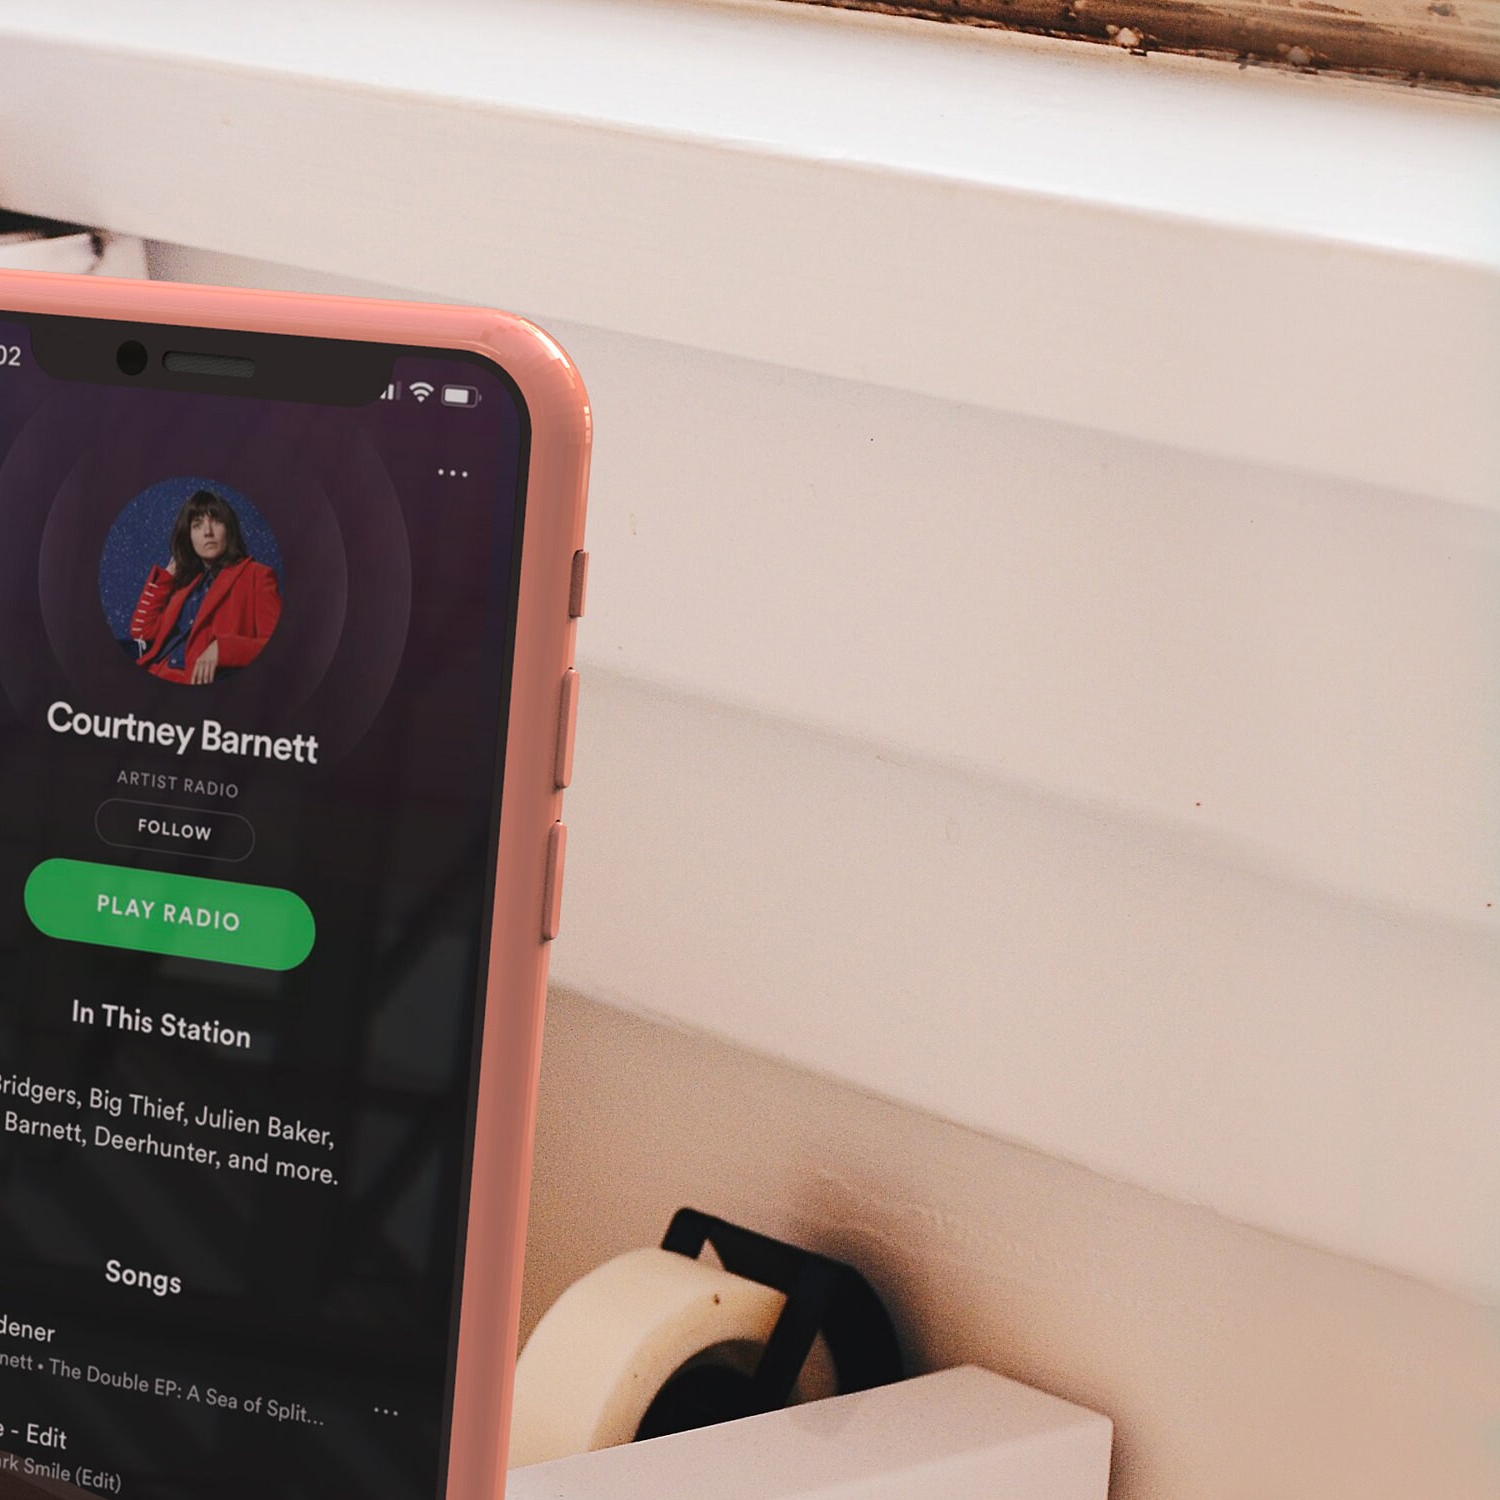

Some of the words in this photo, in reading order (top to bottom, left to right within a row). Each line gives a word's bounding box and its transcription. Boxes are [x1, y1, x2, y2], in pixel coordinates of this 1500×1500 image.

[47, 701, 196, 755] Courtney
[201, 719, 319, 765] Barnett
[116, 770, 178, 790] ARTIST
[183, 778, 239, 799] RADIO
[138, 818, 212, 841] FOLLOW
[97, 894, 155, 919] PLAY
[163, 903, 240, 932] RADIO
[72, 999, 94, 1025] In
[101, 1003, 153, 1034] This
[160, 1013, 251, 1049] Station
[89, 1087, 122, 1117] Big
[128, 1093, 189, 1127] Thief,
[194, 1105, 260, 1135] Julien
[264, 1117, 335, 1150] Baker,
[5, 1111, 87, 1147] Barnett,
[94, 1126, 221, 1169] Deerhunter,
[227, 1152, 269, 1174] and
[275, 1161, 338, 1186] more.
[105, 1259, 181, 1297] Songs
[48, 1357, 82, 1380] The
[86, 1365, 149, 1393] Double
[154, 1378, 182, 1399] EP:
[186, 1384, 201, 1403] A
[205, 1387, 238, 1409] Sea
[243, 1396, 263, 1414] of
[26, 1423, 67, 1450] Edit
[23, 1457, 71, 1482] Smile
[75, 1466, 122, 1494] (Edit)
